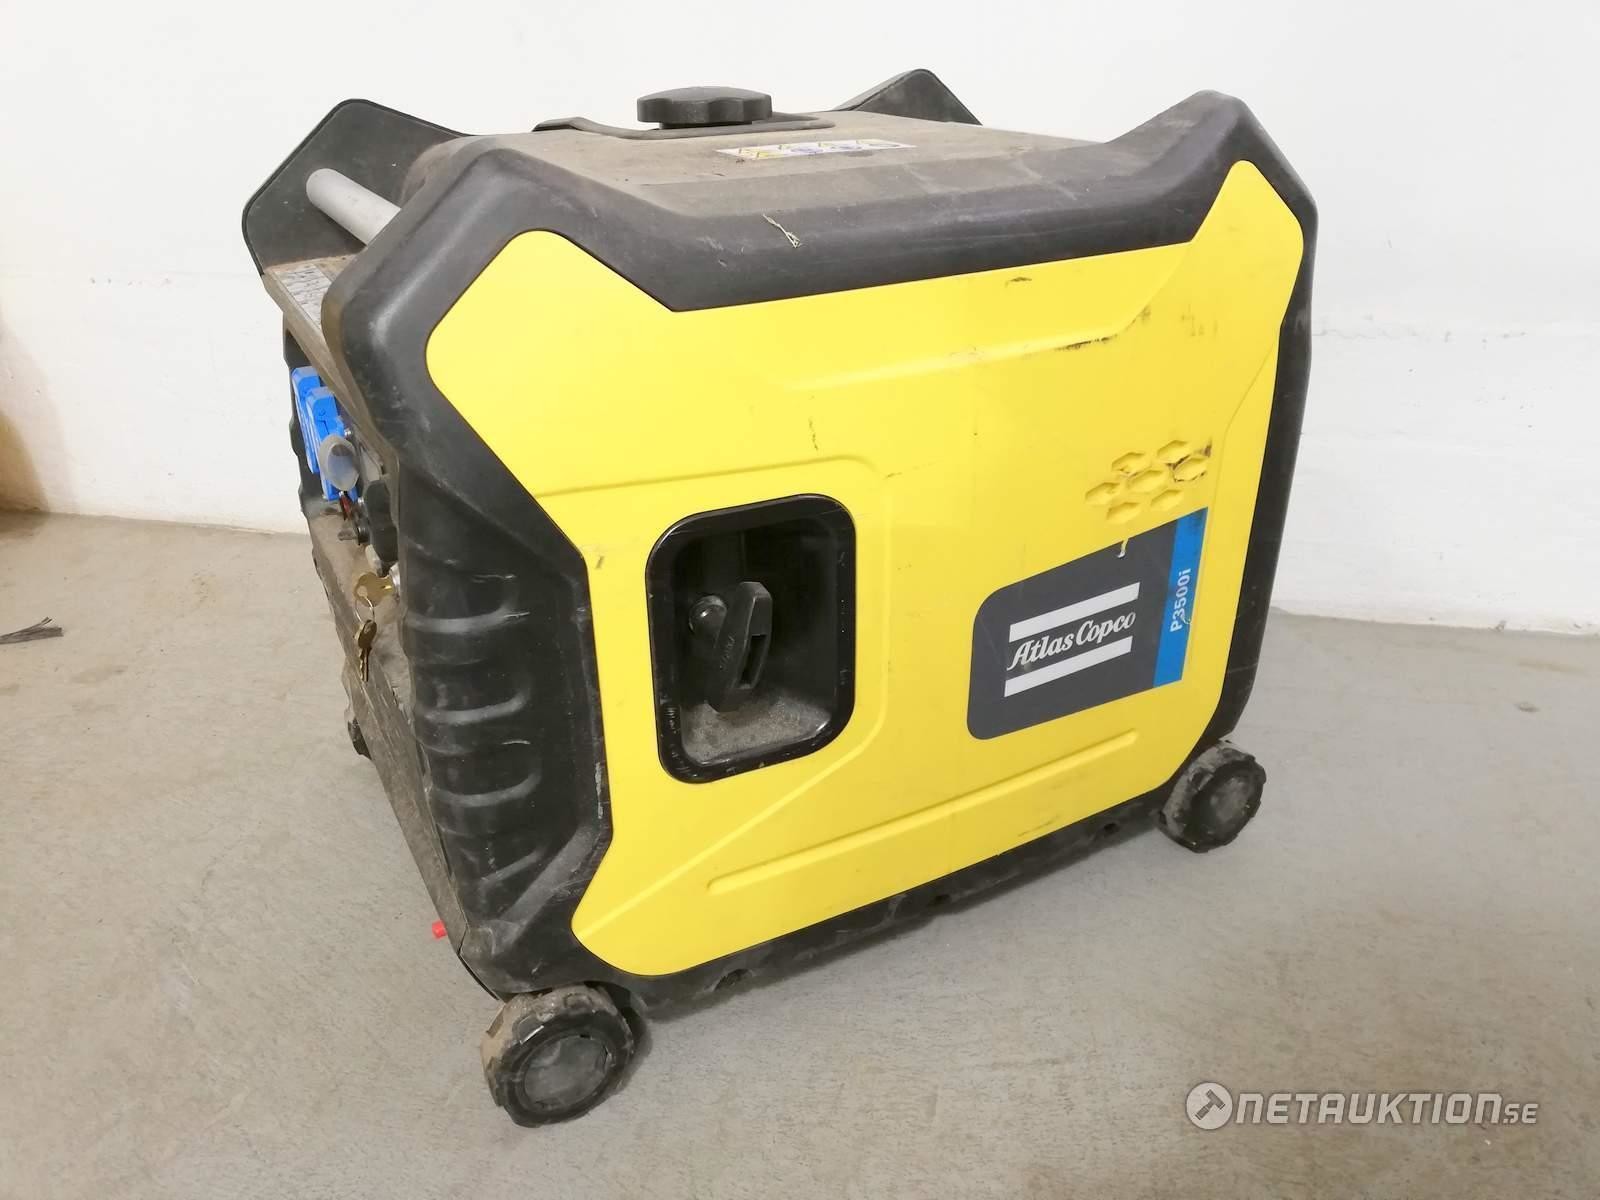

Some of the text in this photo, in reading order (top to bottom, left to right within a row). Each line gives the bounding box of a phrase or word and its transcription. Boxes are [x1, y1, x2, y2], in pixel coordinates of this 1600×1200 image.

[1170, 568, 1191, 632] P3500i
[1007, 612, 1136, 671] Atlas Copco
